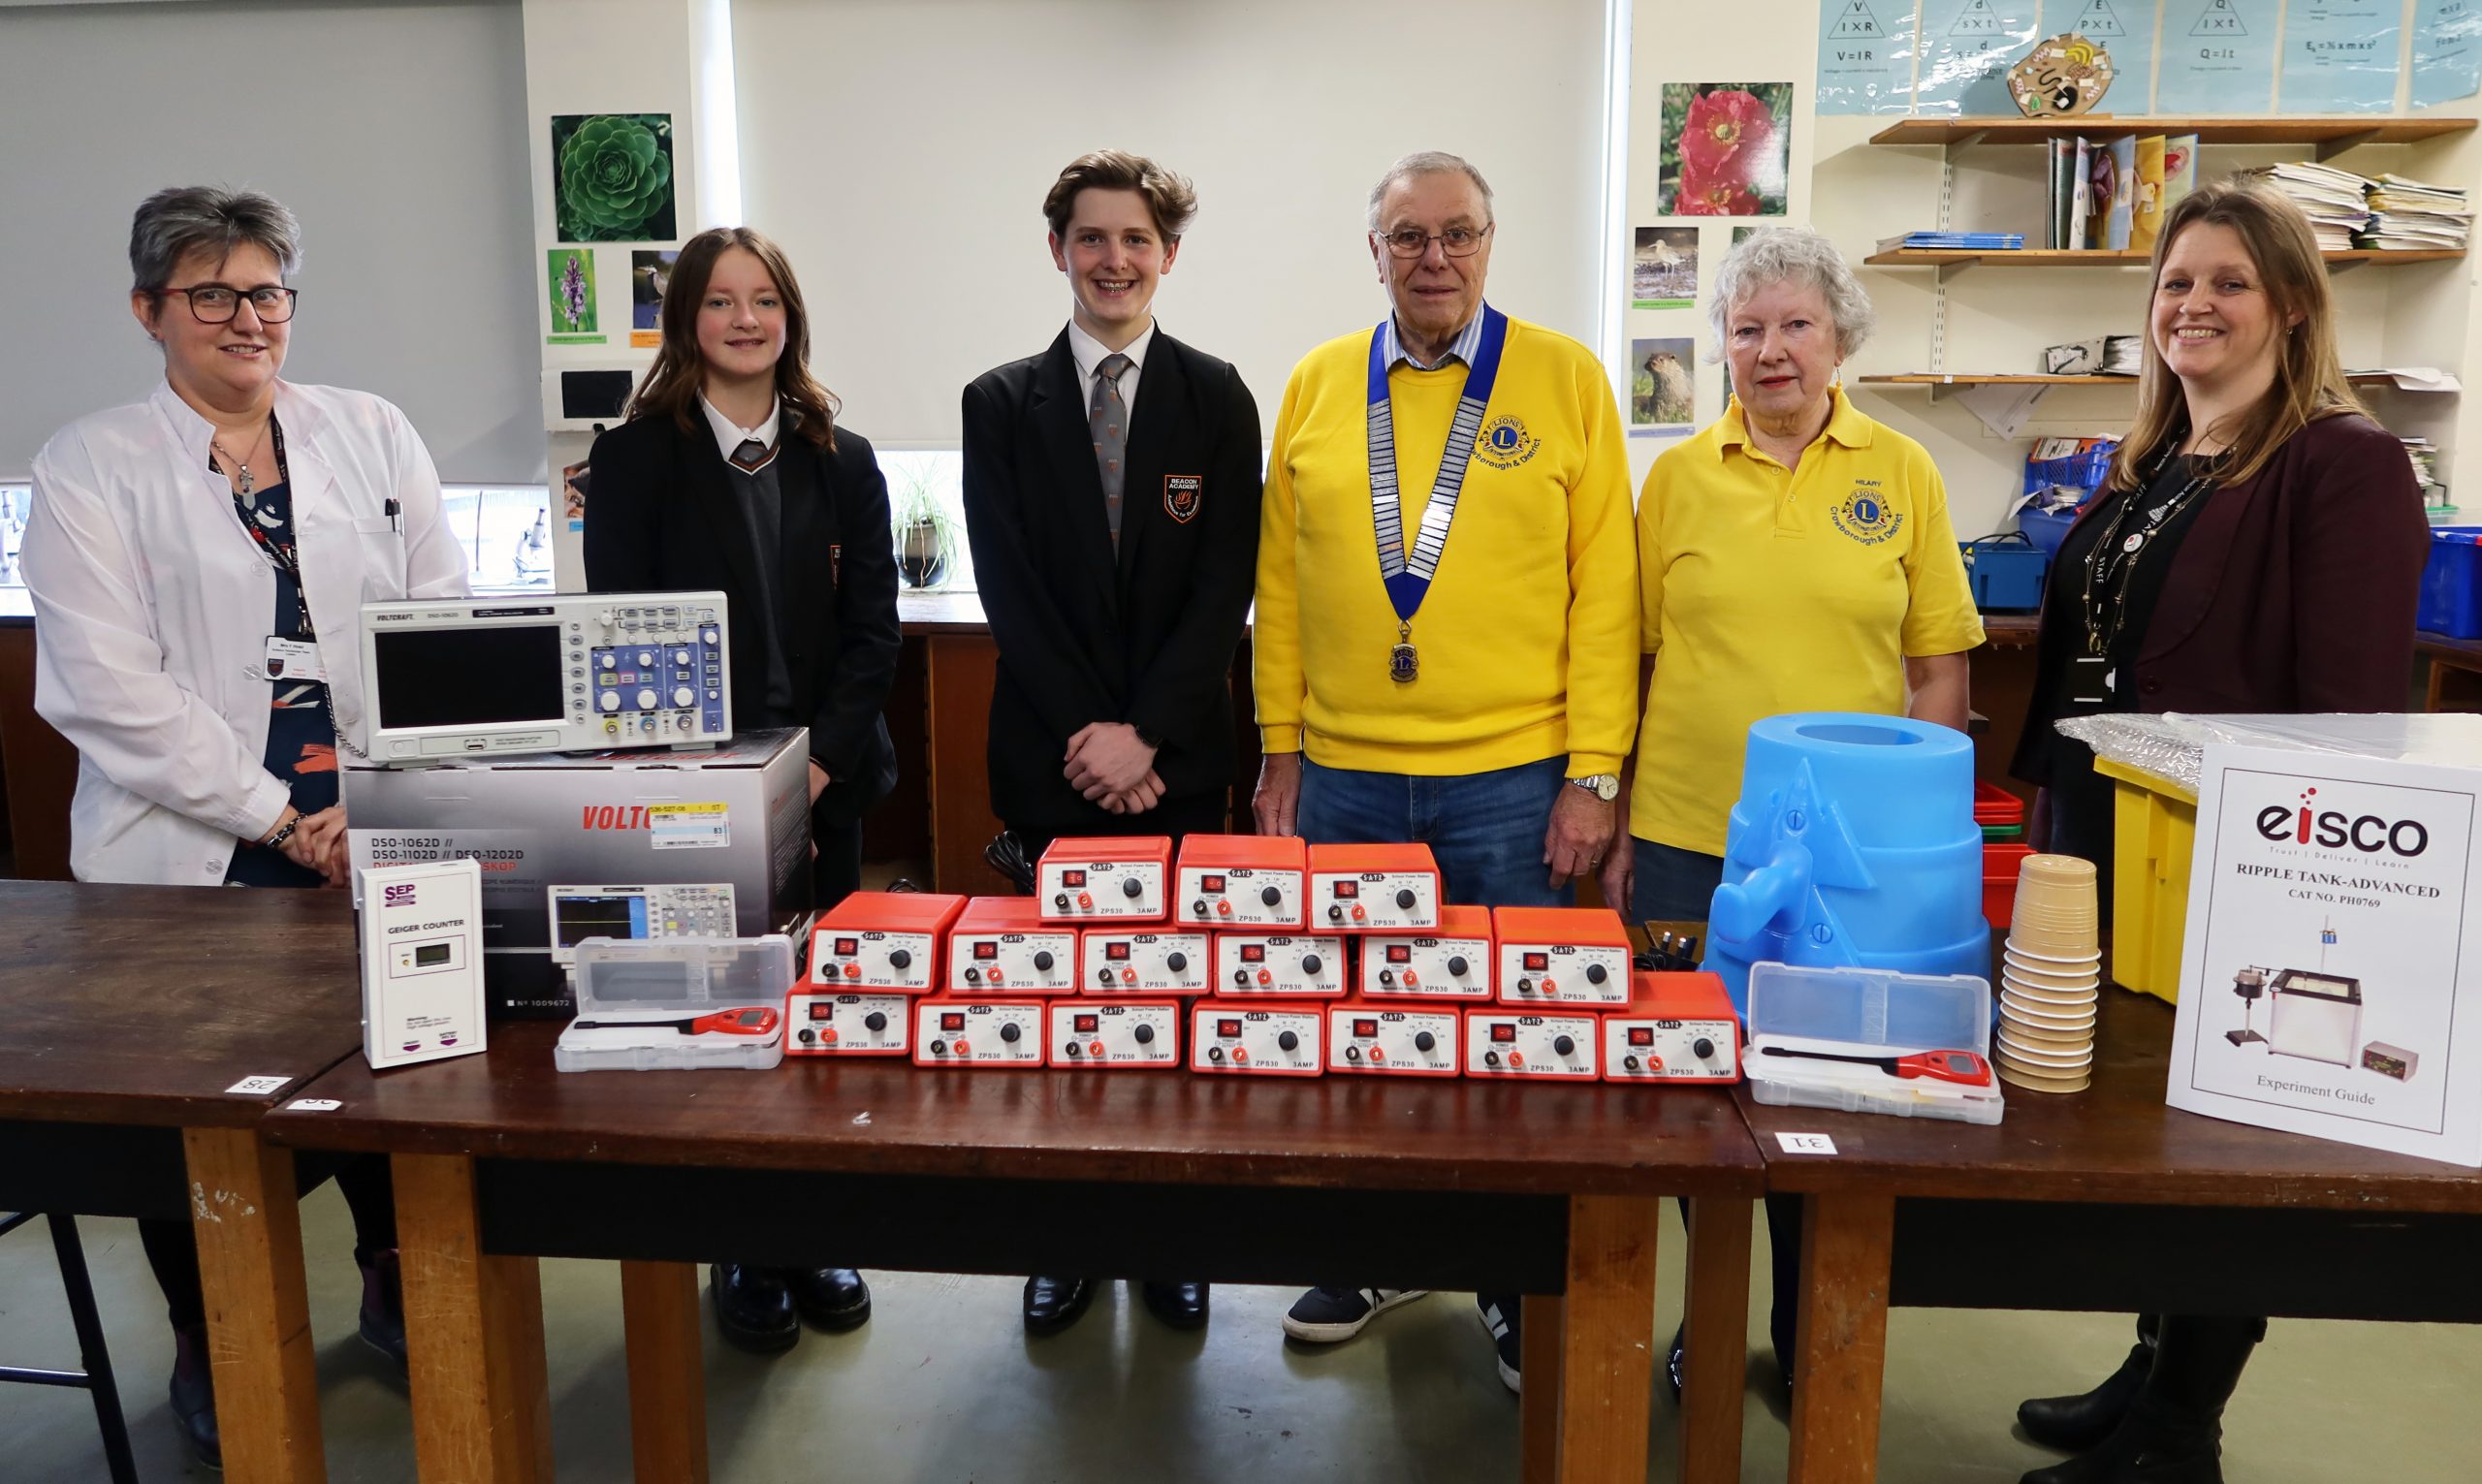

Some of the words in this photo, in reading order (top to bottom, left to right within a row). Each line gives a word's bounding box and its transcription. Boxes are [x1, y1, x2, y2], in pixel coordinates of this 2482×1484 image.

[1493, 418, 1519, 427] LIONS
[1497, 429, 1511, 447] L
[1520, 438, 1541, 463] District
[1854, 490, 1881, 502] LIONS
[1861, 502, 1873, 521] L
[1830, 506, 1877, 547] Crowborough
[1884, 514, 1904, 539] District
[2096, 556, 2106, 584] STAFF
[2257, 787, 2428, 857] eisco
[372, 837, 440, 847] DSO-1062D
[372, 850, 437, 859] DSO-1102D
[456, 850, 524, 859] DSO-1202D
[2271, 846, 2298, 857] Trust
[2315, 851, 2359, 863] Deliver
[2375, 859, 2409, 869] Learn
[481, 862, 518, 871] SKOP
[2238, 863, 2294, 880] RIPPLE
[2298, 870, 2440, 899] TANK-ADVANCED
[384, 884, 415, 900] SEP
[2288, 889, 2311, 900] CAT
[2315, 893, 2336, 903] NO.
[2339, 896, 2381, 908] PH0769
[388, 925, 420, 934] GEIGER
[423, 920, 464, 930] COUNTER
[242, 1080, 278, 1089] 28
[2257, 1075, 2331, 1097] Experiment
[2335, 1088, 2375, 1105] Guide
[1794, 1137, 1824, 1148] 31
